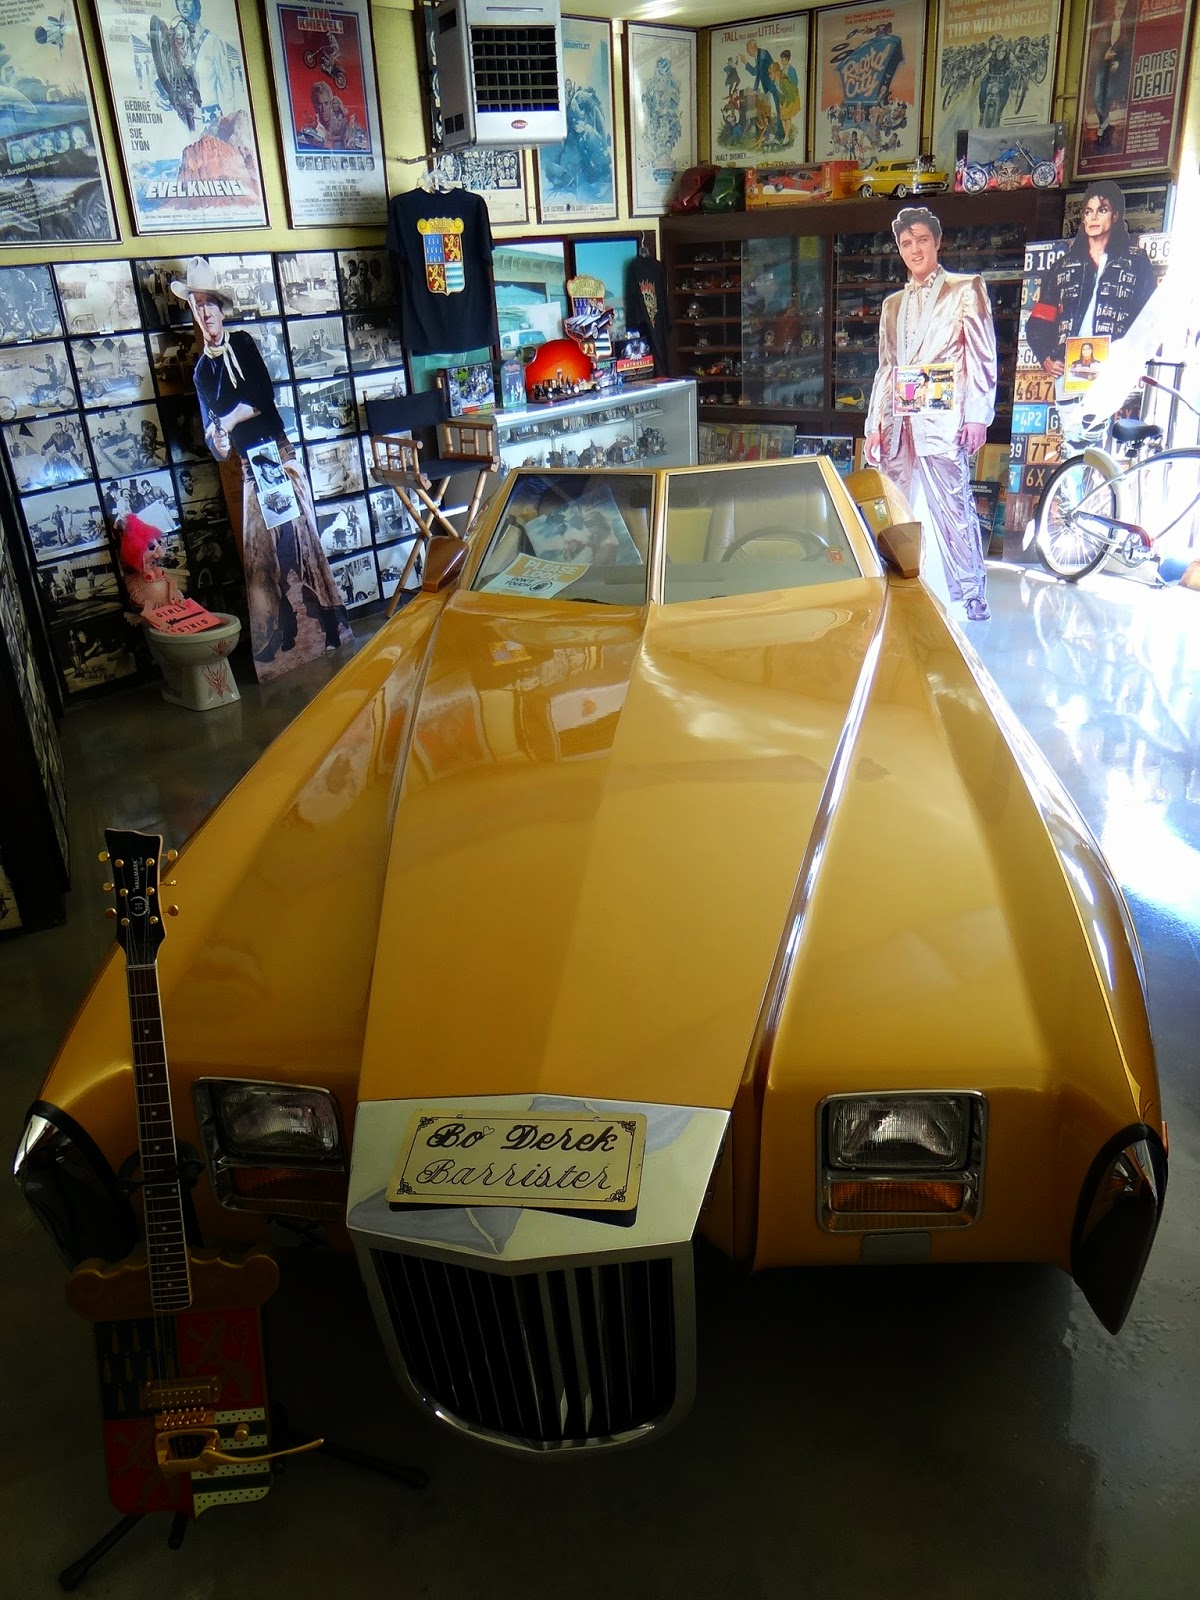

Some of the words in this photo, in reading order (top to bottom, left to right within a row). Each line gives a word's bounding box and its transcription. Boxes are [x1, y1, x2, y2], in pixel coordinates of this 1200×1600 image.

[947, 21, 970, 38] THE
[973, 16, 1002, 34] WILD
[1003, 8, 1049, 29] ANGELS
[724, 32, 738, 42] TALL
[758, 24, 780, 36] LITTLE
[842, 44, 891, 84] Record
[1135, 49, 1177, 75] JAMES
[846, 73, 879, 97] City
[1132, 69, 1174, 101] DEAN
[124, 100, 151, 112] GEORGE
[126, 113, 163, 124] HAMILTON
[129, 128, 143, 139] SUE
[131, 141, 150, 151] LYON
[145, 180, 187, 199] EVEL
[521, 569, 559, 581] LOOK
[524, 560, 579, 575] PLEASE
[156, 606, 187, 618] GIRLS
[178, 619, 208, 632] GIRLS
[426, 1123, 485, 1149] Bo
[500, 1124, 618, 1152] Derek
[415, 1159, 612, 1190] Barrister
